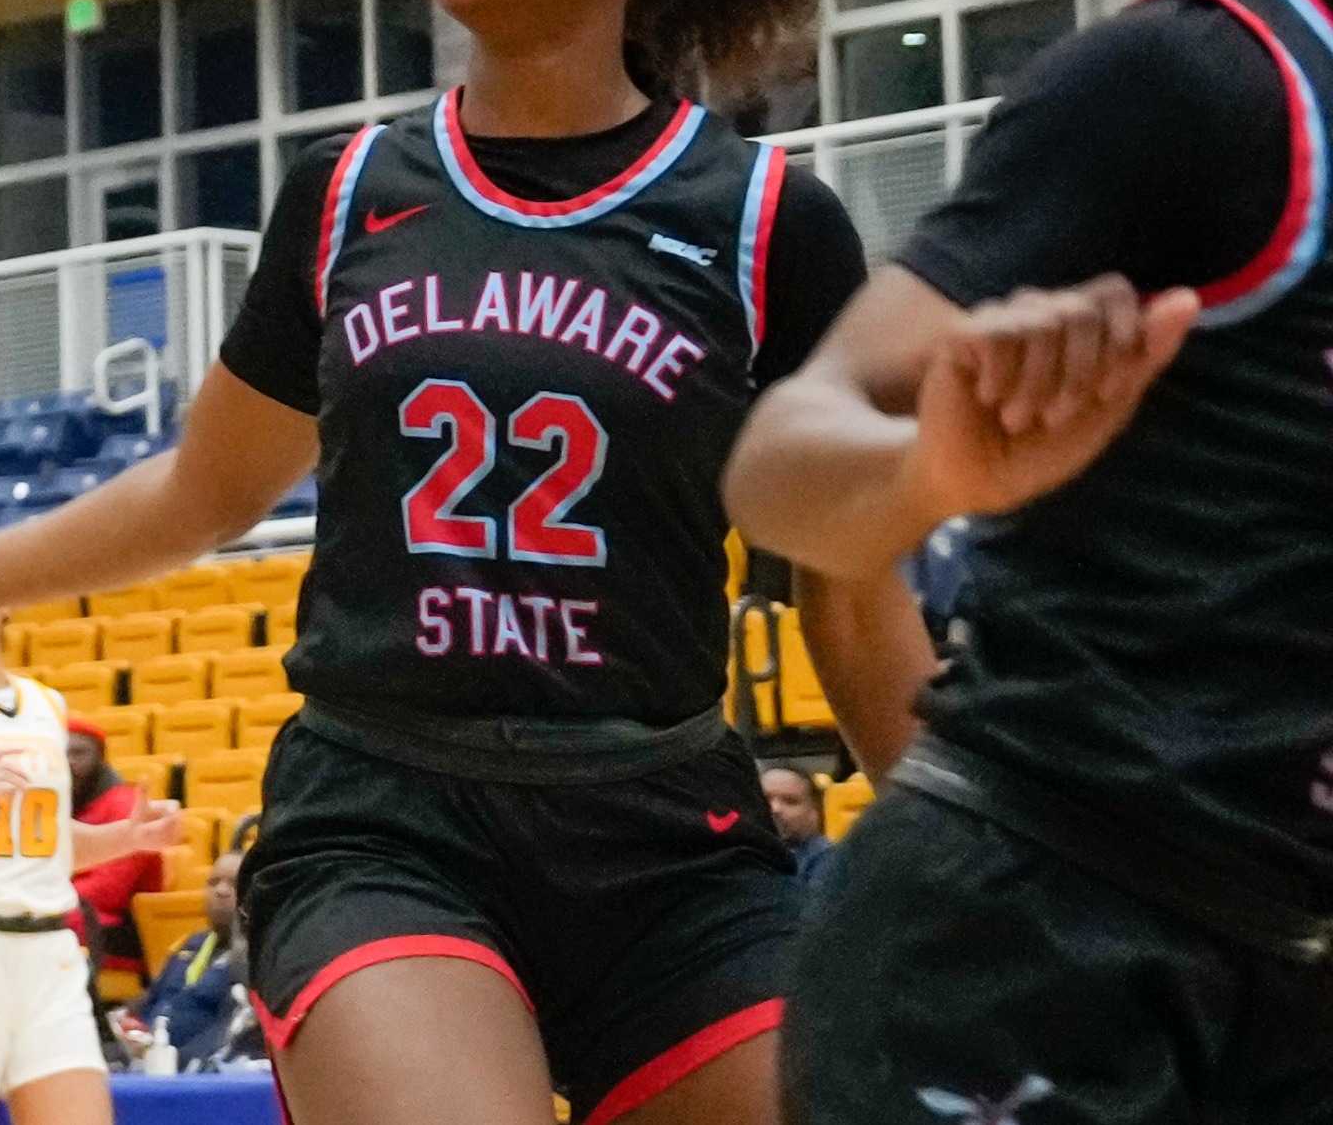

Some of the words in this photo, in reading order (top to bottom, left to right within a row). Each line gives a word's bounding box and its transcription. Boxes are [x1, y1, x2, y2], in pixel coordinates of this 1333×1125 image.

[343, 271, 706, 400] DELAWARE
[398, 377, 610, 567] 22
[415, 587, 604, 665] STATE
